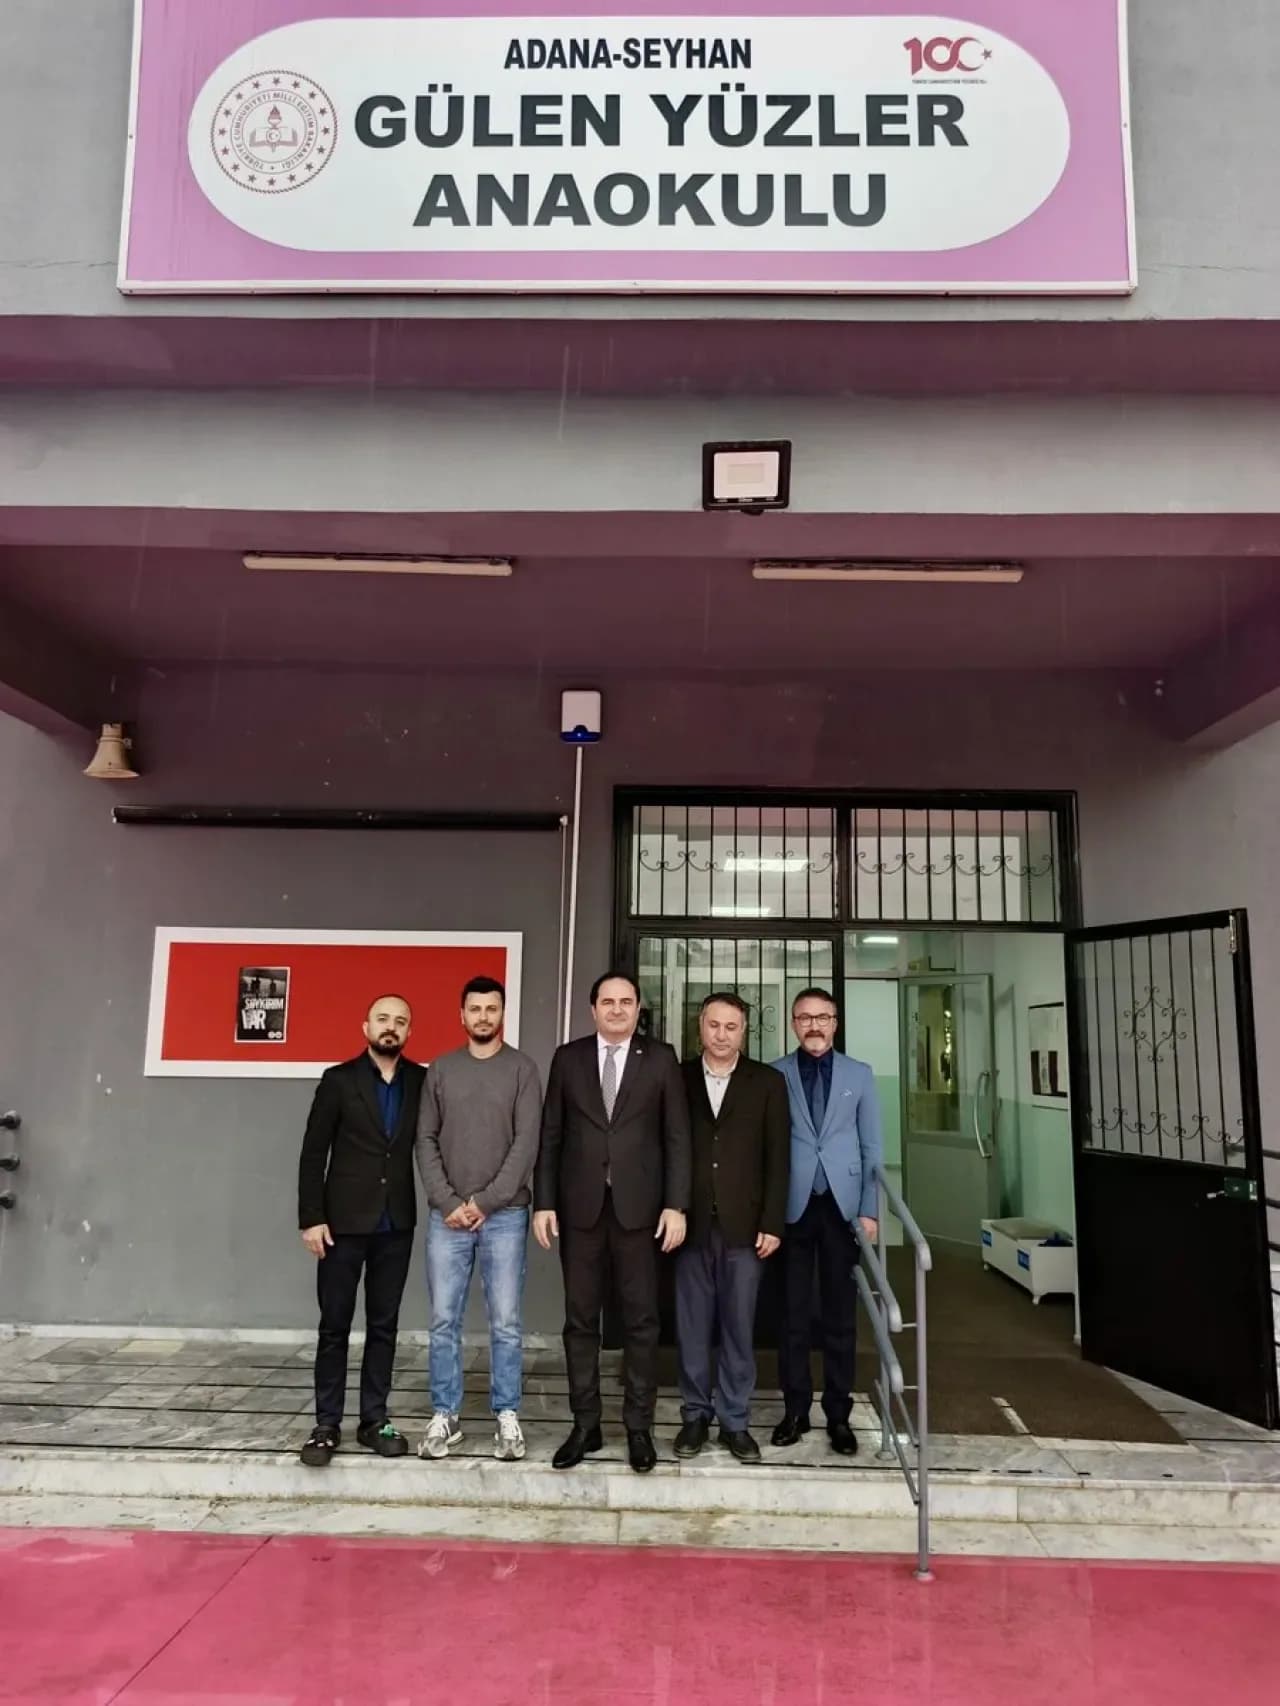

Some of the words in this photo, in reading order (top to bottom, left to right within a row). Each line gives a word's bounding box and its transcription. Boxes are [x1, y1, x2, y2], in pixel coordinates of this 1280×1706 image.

[503, 37, 752, 70] ADANA-SEYHAN
[354, 83, 621, 149] GÜLEN
[649, 81, 969, 149] YÜZLER
[413, 172, 886, 227] ANAOKULU
